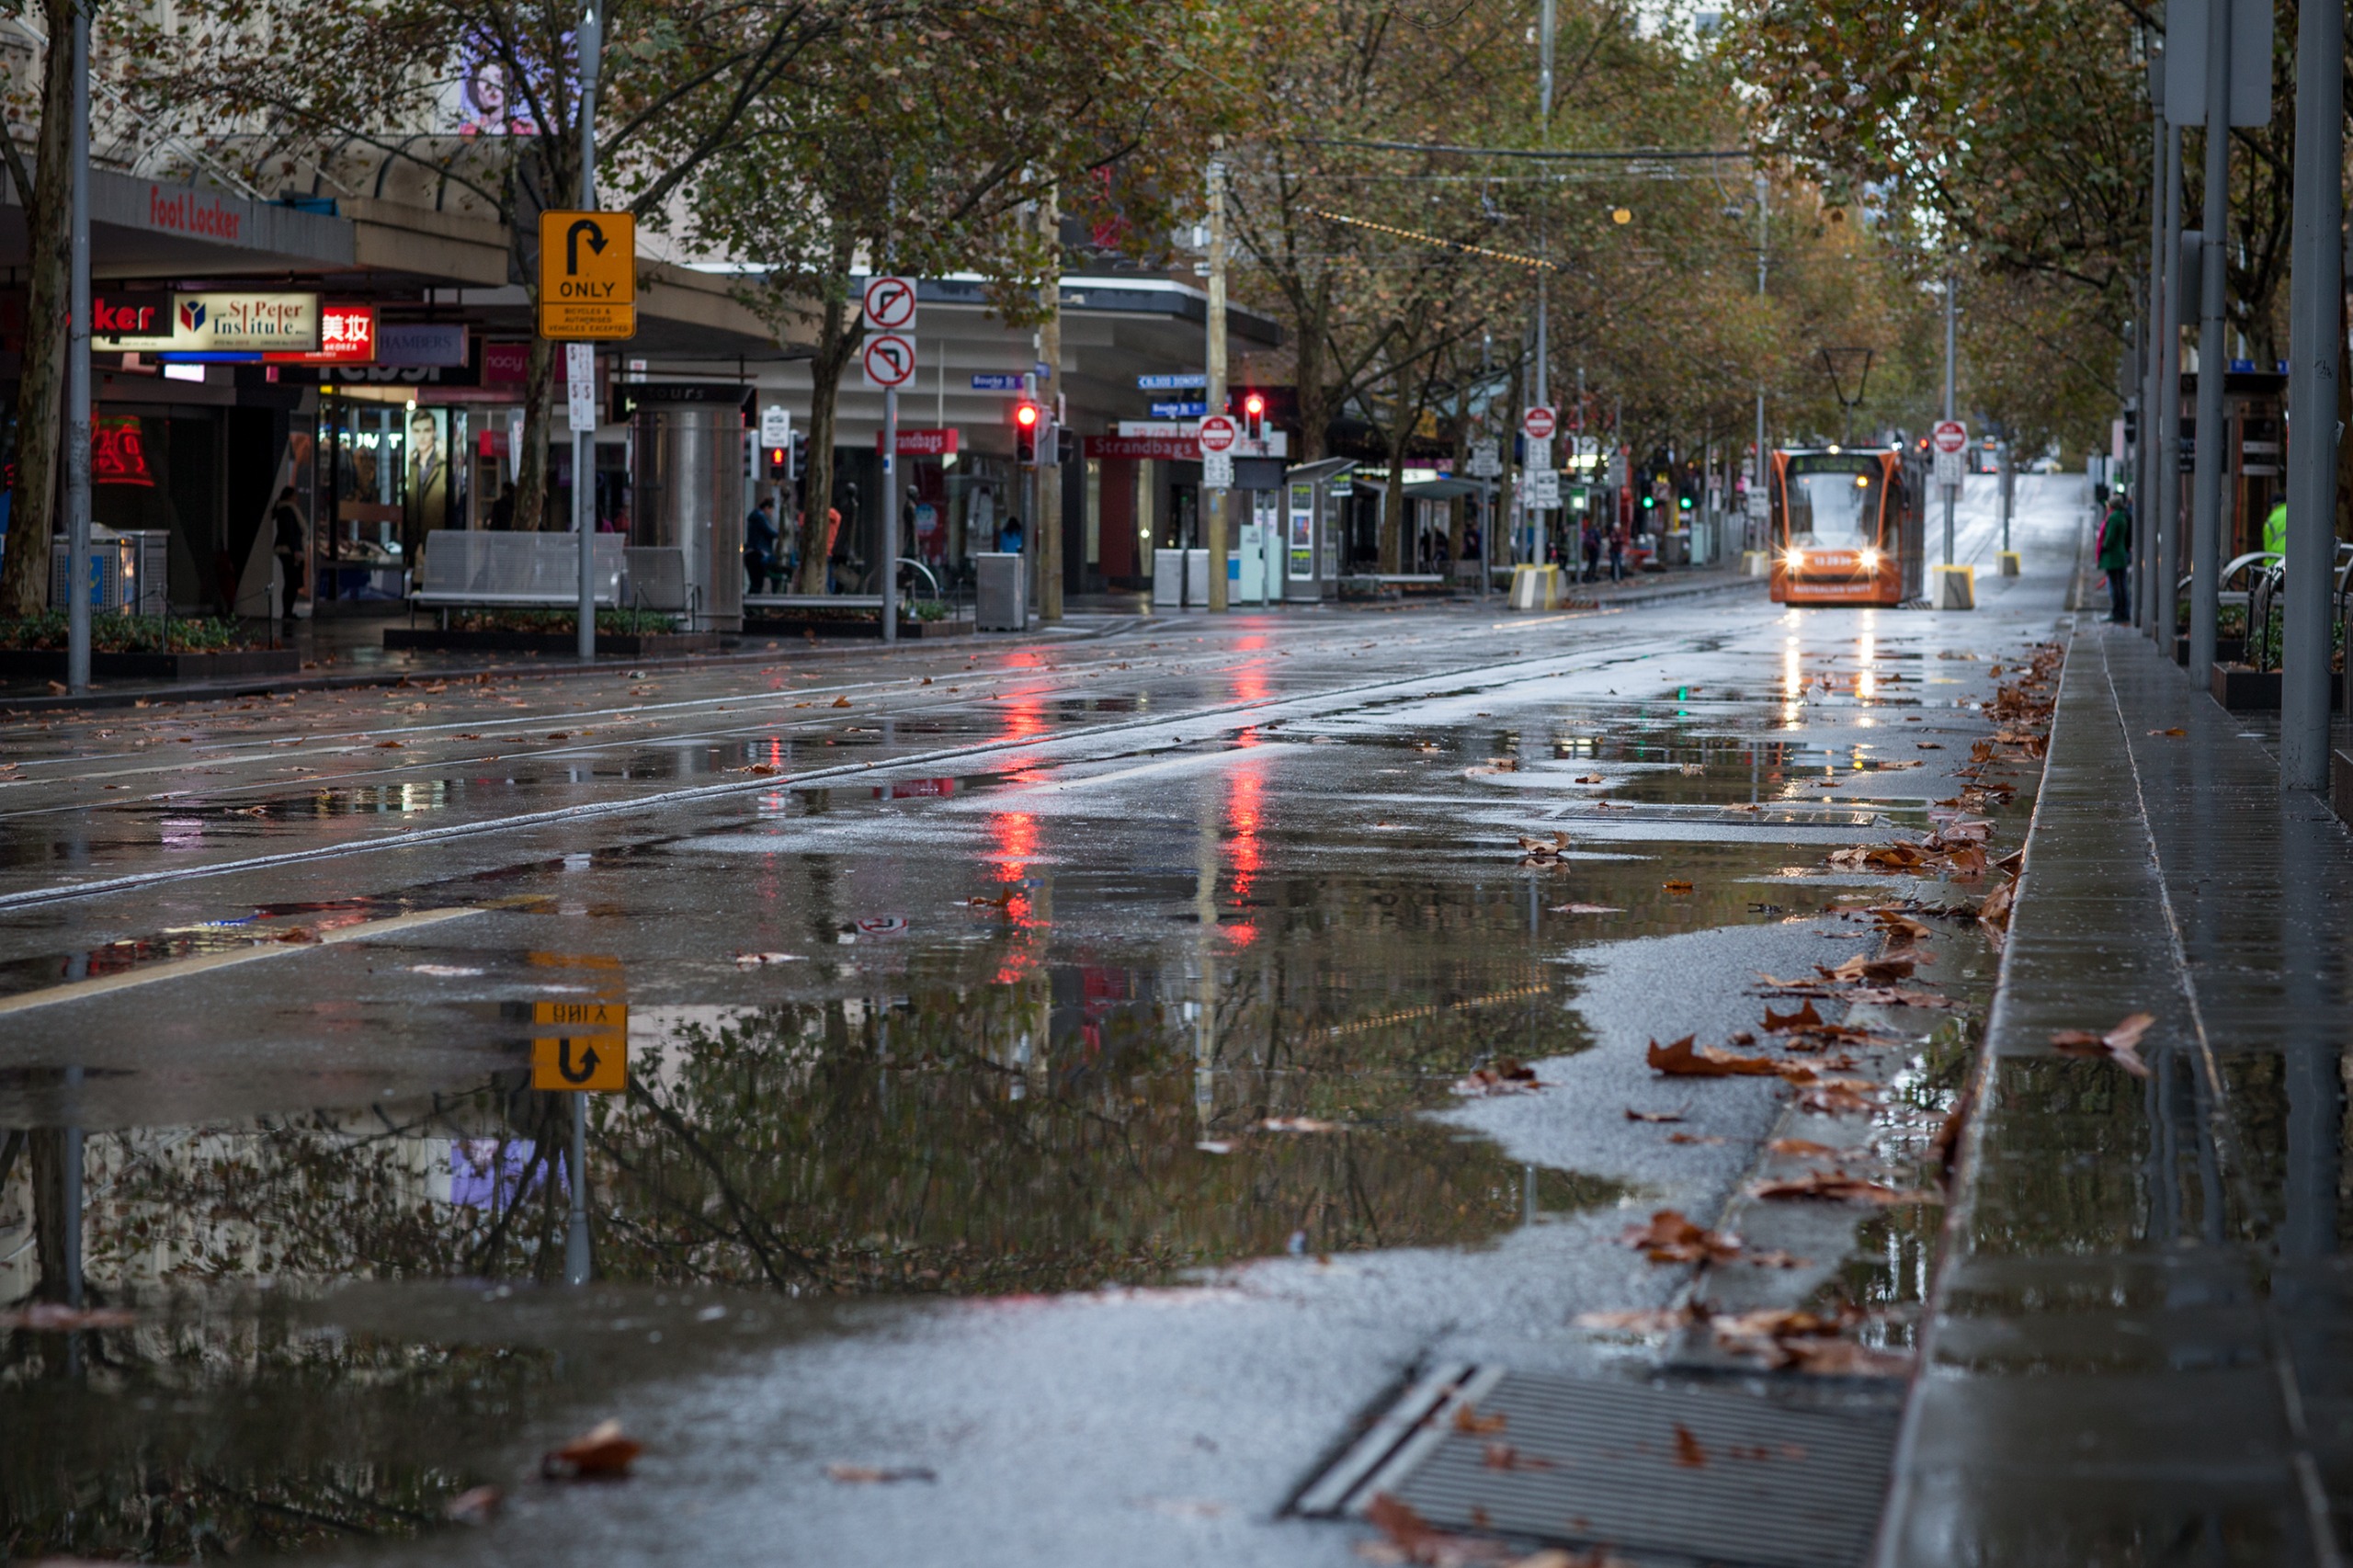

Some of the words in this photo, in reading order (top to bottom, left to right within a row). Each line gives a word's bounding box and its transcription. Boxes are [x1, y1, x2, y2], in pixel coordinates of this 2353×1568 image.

[151, 185, 185, 232] Foot
[189, 192, 240, 241] Locker
[560, 281, 615, 297] ONLY
[90, 298, 154, 331] ker
[255, 301, 303, 334] Peter
[214, 317, 293, 335] Institute
[323, 314, 369, 342] 美妆
[380, 335, 451, 349] HAMBERS
[974, 375, 1003, 385] Bourke
[1211, 421, 1224, 429] NO
[895, 432, 943, 452] randbags
[1095, 438, 1192, 459] Strandbags
[1205, 438, 1229, 447] ENTRY
